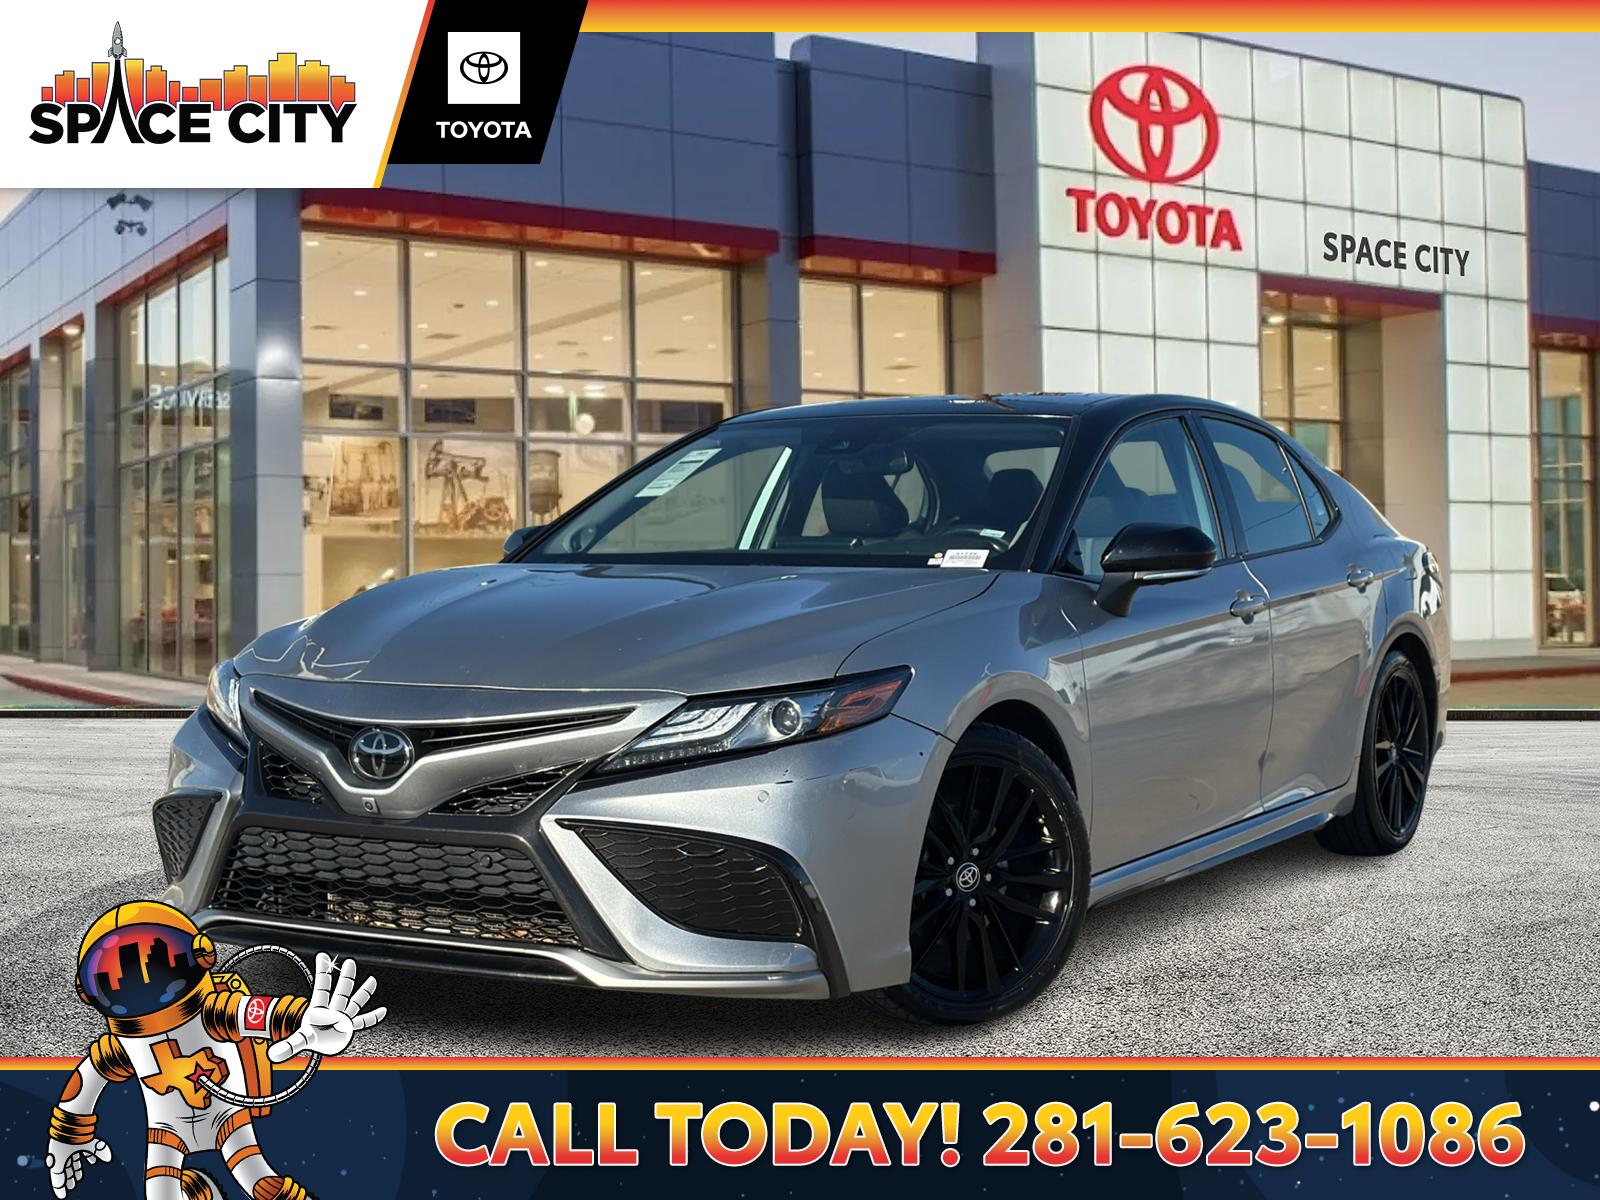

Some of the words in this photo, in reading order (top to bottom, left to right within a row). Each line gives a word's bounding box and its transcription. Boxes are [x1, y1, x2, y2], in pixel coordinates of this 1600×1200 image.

[1066, 187, 1242, 251] TOYOTA
[1323, 232, 1407, 270] SPACE
[1414, 244, 1470, 277] CITY
